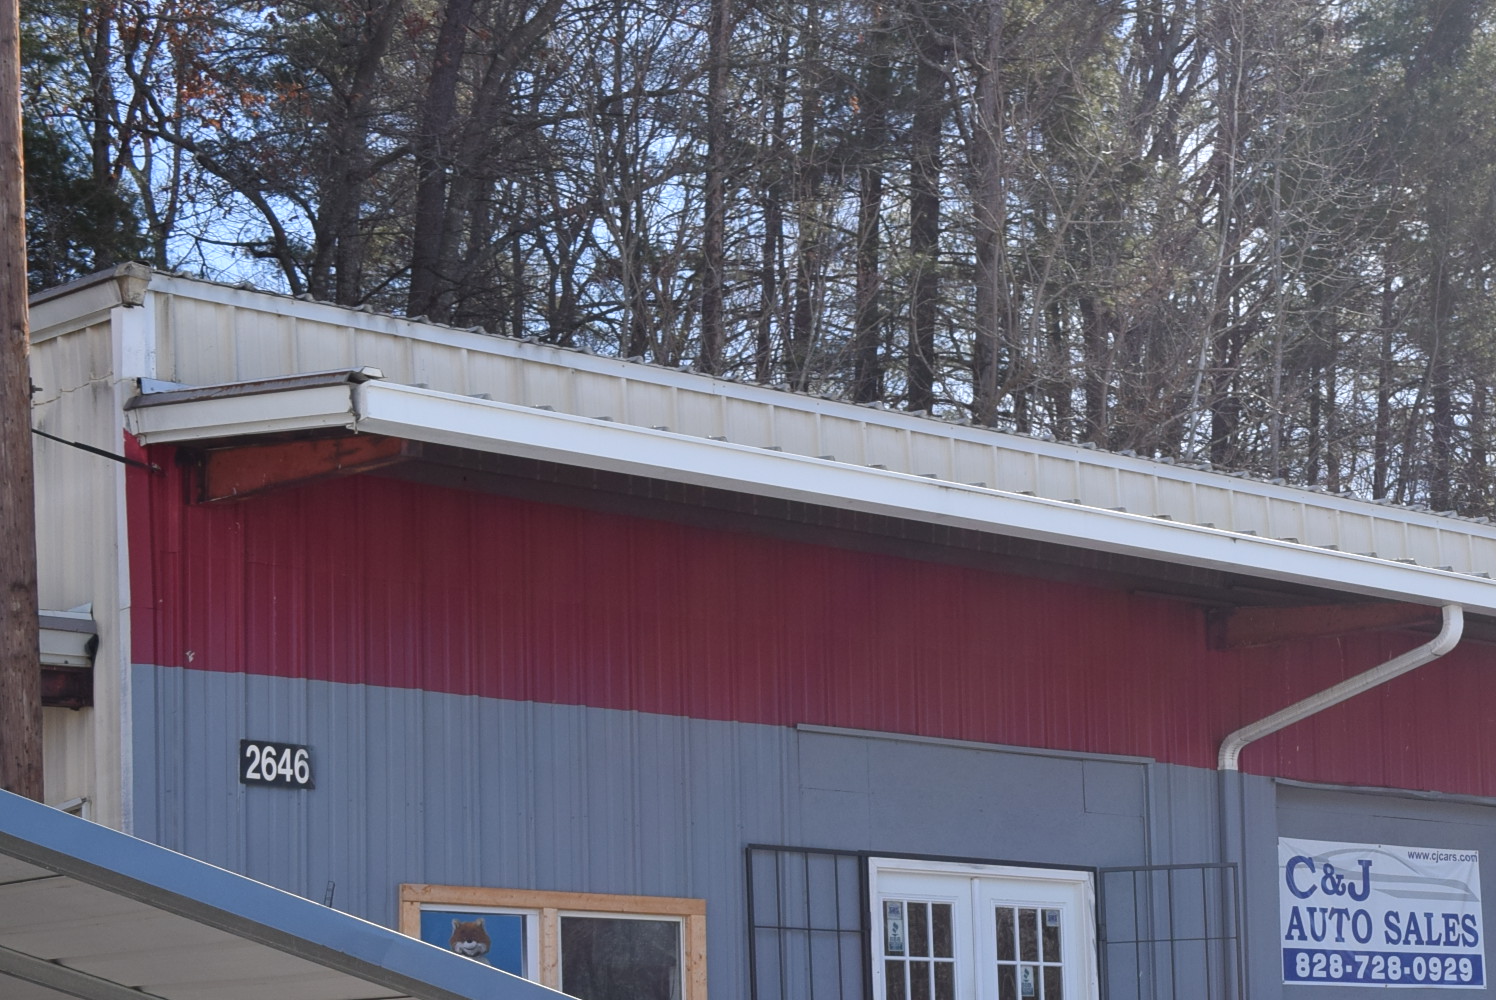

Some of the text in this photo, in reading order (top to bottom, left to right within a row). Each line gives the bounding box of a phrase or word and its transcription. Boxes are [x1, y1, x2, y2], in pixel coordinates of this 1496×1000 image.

[245, 744, 310, 784] 2646
[1407, 851, 1478, 864] www.cjcars.com
[1285, 855, 1373, 902] C&J
[1285, 905, 1479, 948] AUTO SALES
[1295, 952, 1473, 982] 828-728-0929
